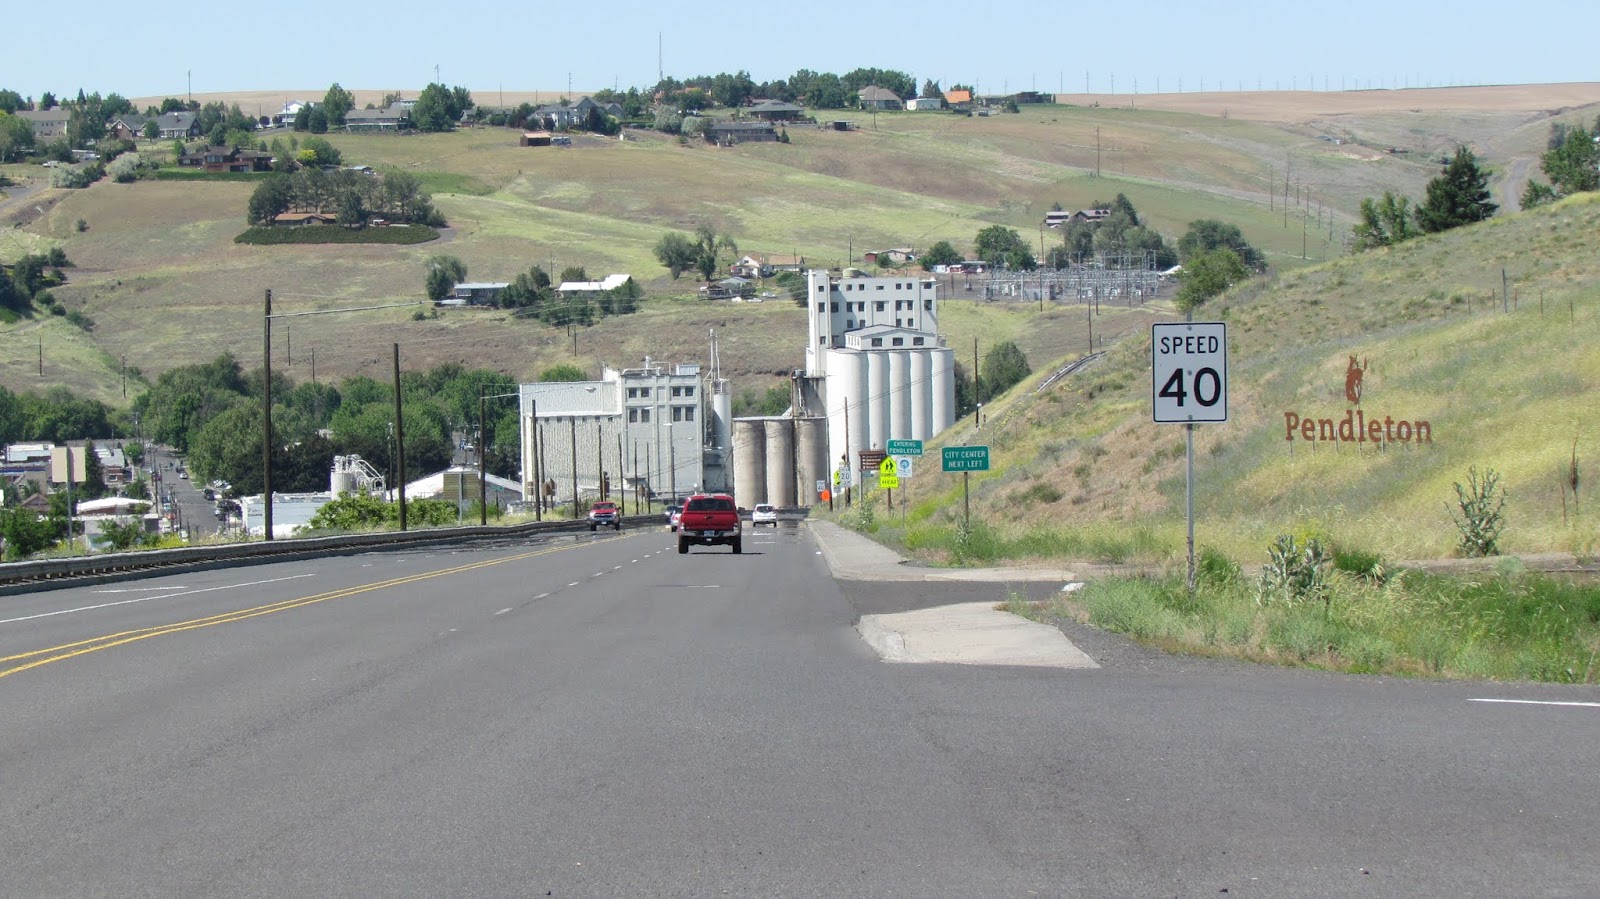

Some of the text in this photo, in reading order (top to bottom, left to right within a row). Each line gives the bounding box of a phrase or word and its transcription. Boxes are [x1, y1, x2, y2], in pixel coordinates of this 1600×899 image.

[1160, 336, 1219, 354] SPEED
[1158, 367, 1221, 407] 40
[1284, 409, 1433, 444] Pendleton
[944, 450, 986, 459] CITY CENTER
[841, 472, 850, 480] 20
